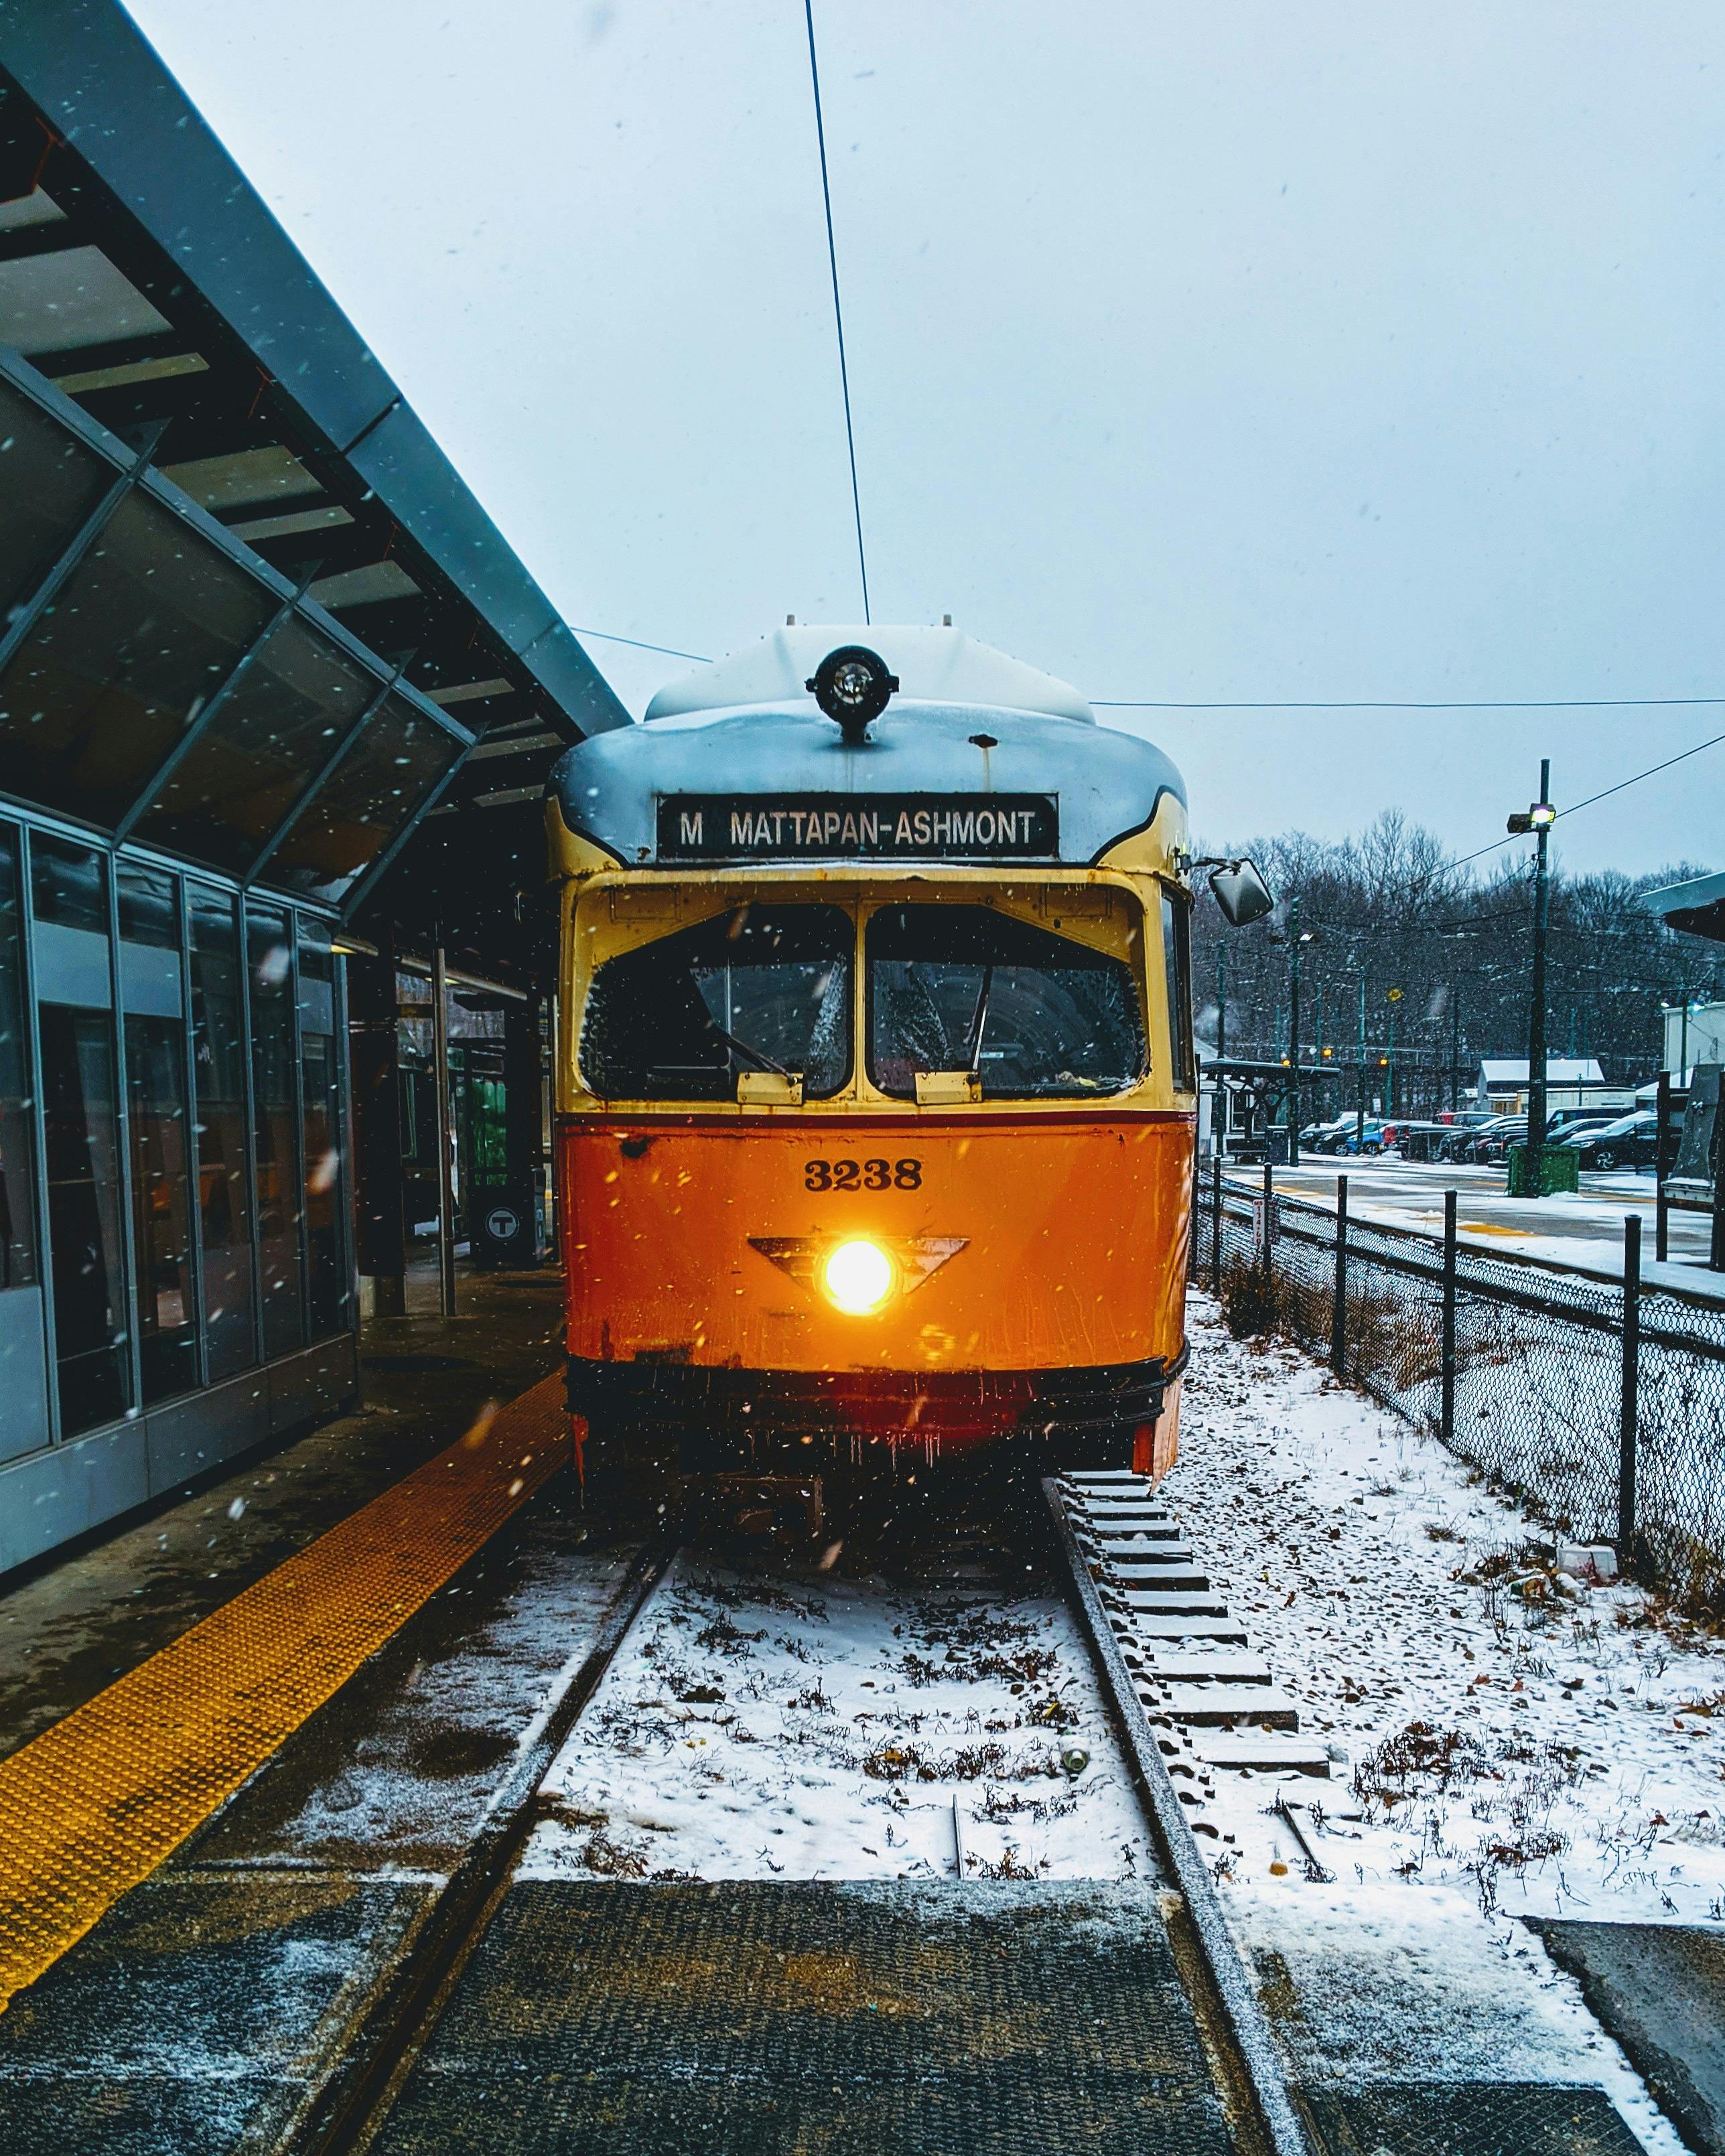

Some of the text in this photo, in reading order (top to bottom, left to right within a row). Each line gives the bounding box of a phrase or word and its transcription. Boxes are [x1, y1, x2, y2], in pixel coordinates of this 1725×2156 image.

[681, 810, 1036, 845] M MATTAPAN-ASHMONT
[805, 1158, 922, 1192] 3238
[492, 1216, 513, 1234] T
